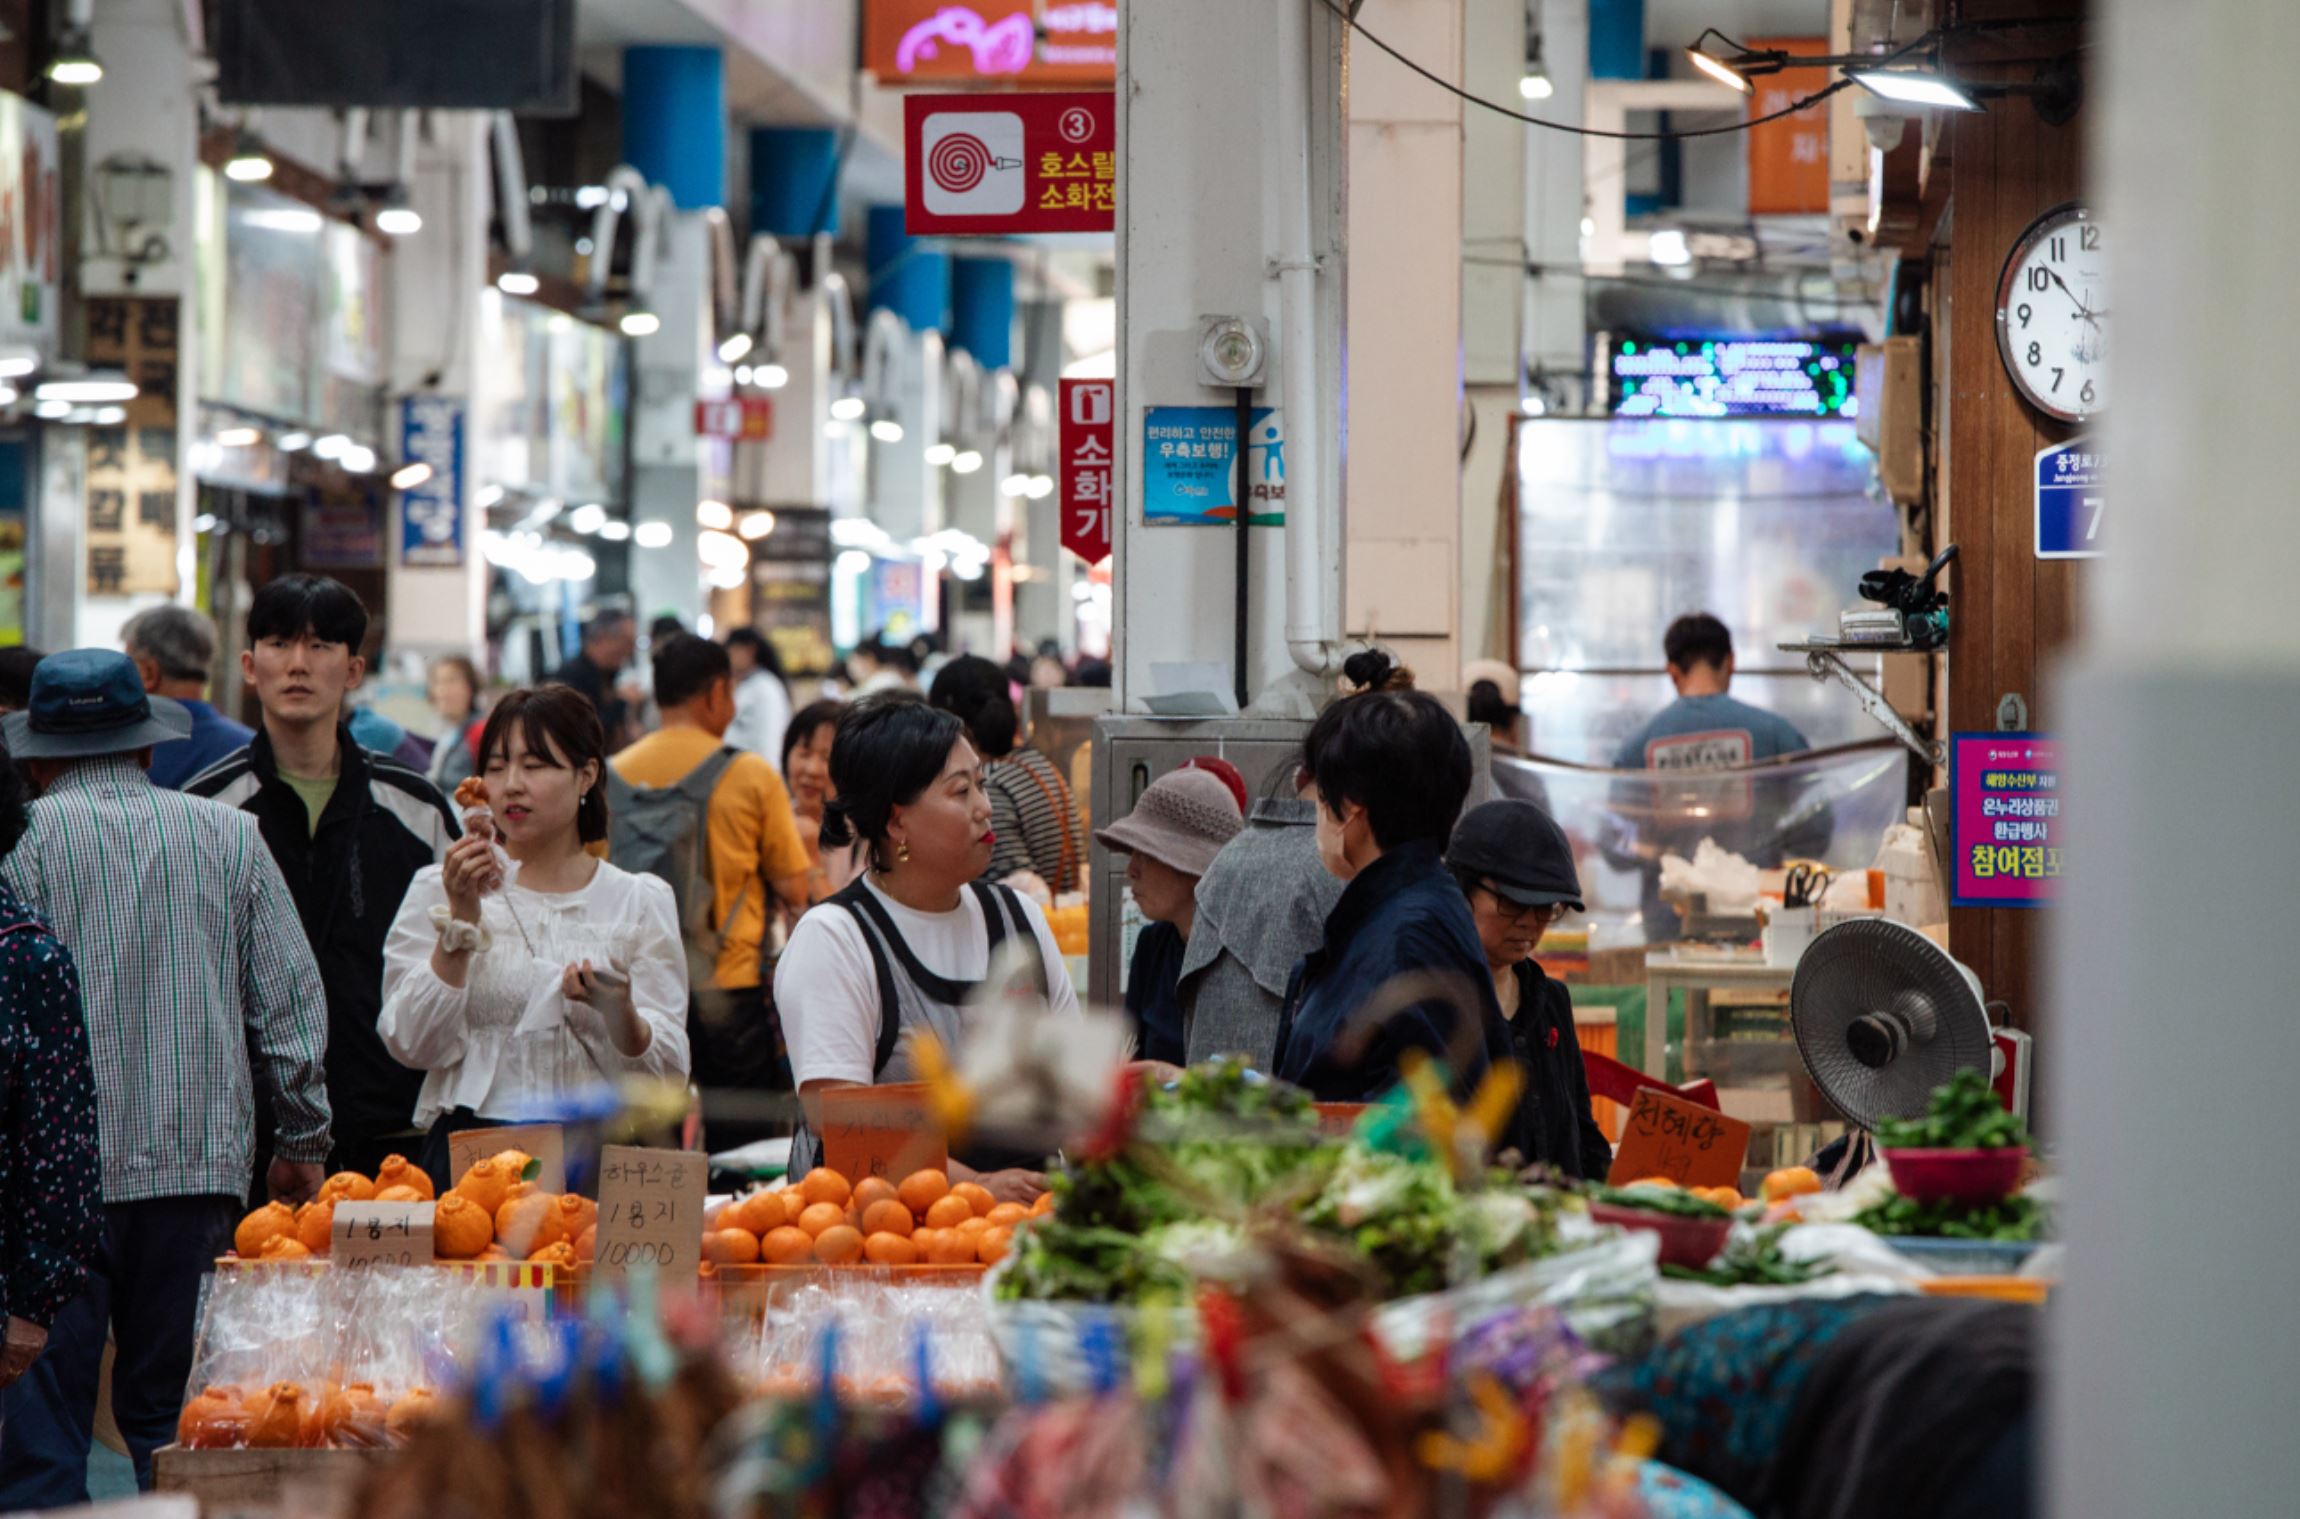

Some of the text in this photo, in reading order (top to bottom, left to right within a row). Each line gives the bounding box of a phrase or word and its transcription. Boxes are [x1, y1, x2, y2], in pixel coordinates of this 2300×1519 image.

[1068, 113, 1085, 137] 3
[1039, 152, 1115, 179] 호스릴
[1040, 183, 1115, 211] 소화전
[2051, 238, 2065, 262] 11
[2080, 226, 2100, 251] 12
[2028, 267, 2049, 291] 10
[2017, 303, 2031, 328] 9
[2027, 341, 2041, 366] 8
[2051, 368, 2064, 392] 7
[2080, 380, 2094, 402] 6
[1147, 426, 1194, 440] 편리하고
[1160, 442, 1229, 459] 우측보행!
[1073, 434, 1112, 544] 소화기
[1986, 773, 2036, 788] 해양수산부
[1982, 797, 2059, 817] 온누리상품권
[1993, 821, 2047, 841] 환급행사
